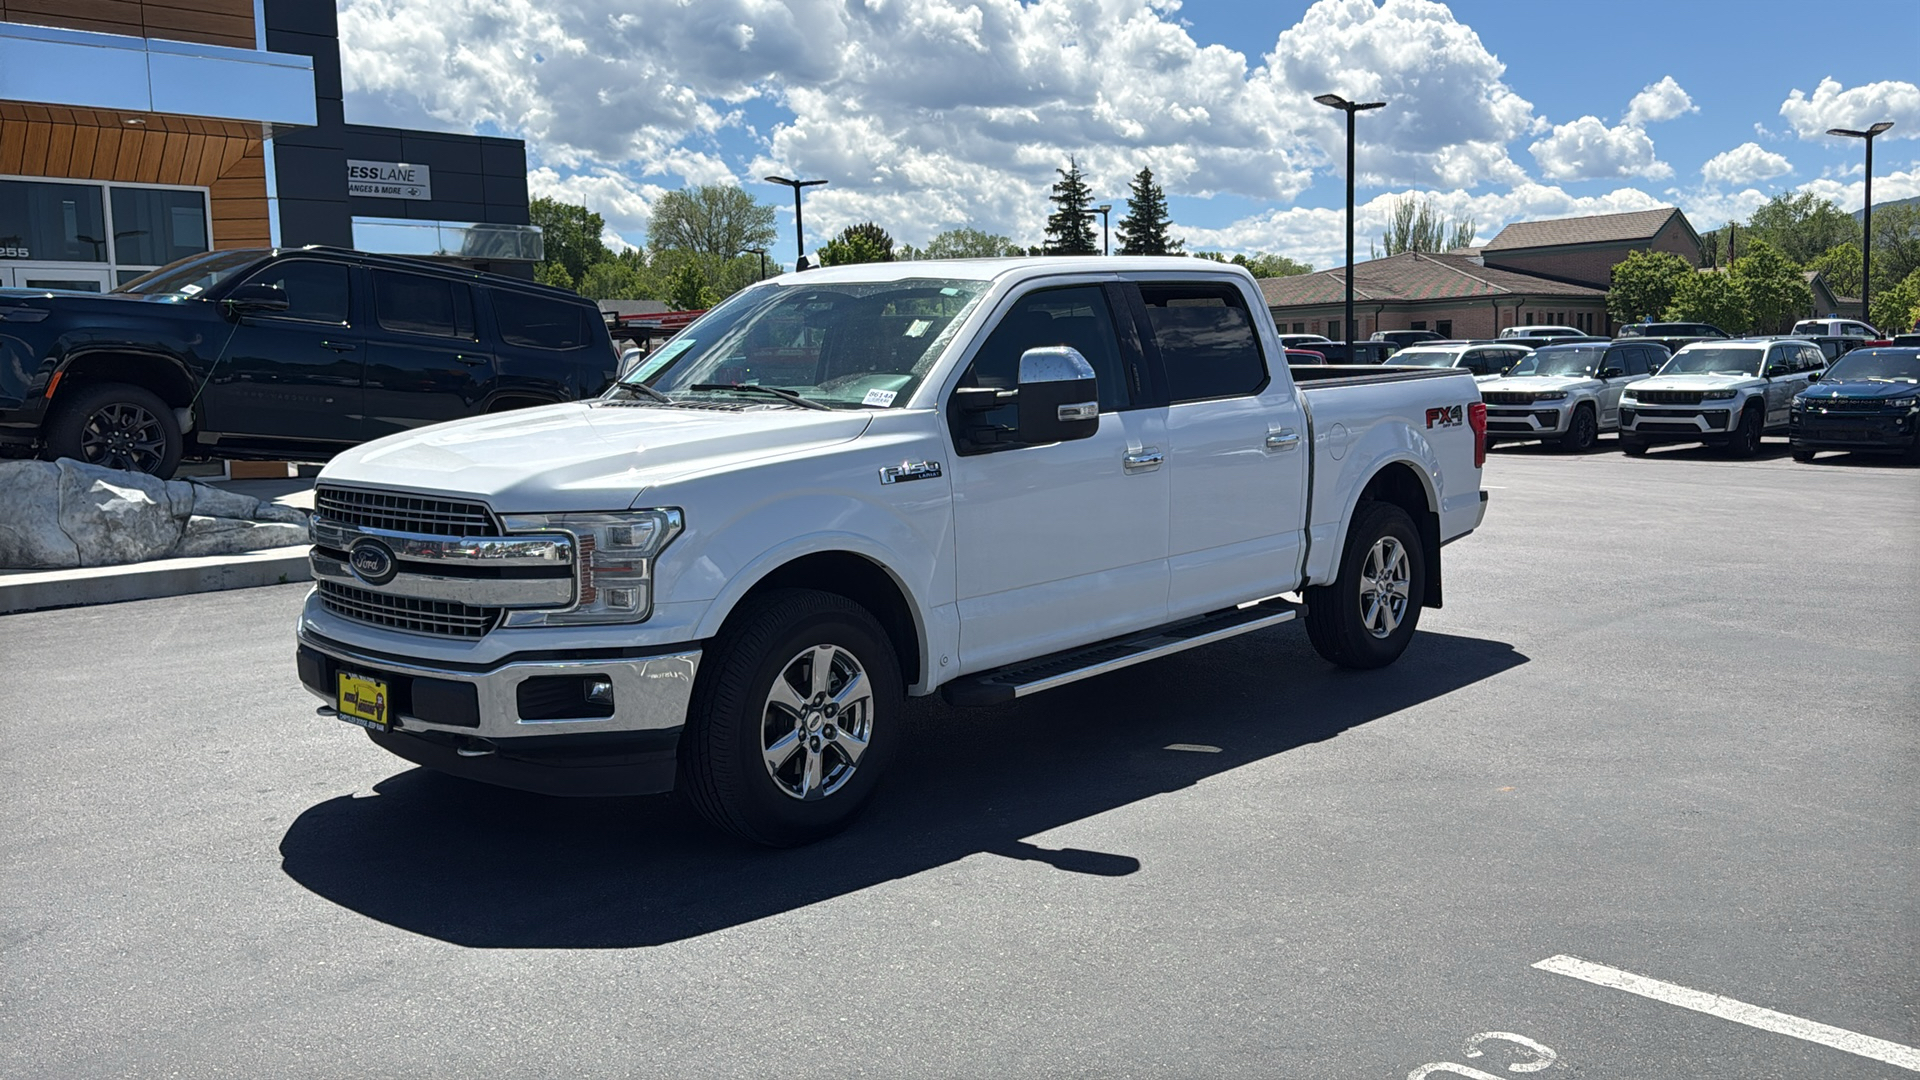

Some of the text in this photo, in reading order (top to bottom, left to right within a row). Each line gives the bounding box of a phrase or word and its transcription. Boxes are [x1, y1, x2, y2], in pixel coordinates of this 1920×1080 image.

[348, 165, 416, 183] ESSLANE
[374, 185, 380, 194] &
[381, 186, 402, 195] MORE
[1425, 405, 1463, 429] FX4
[356, 551, 379, 571] Ford
